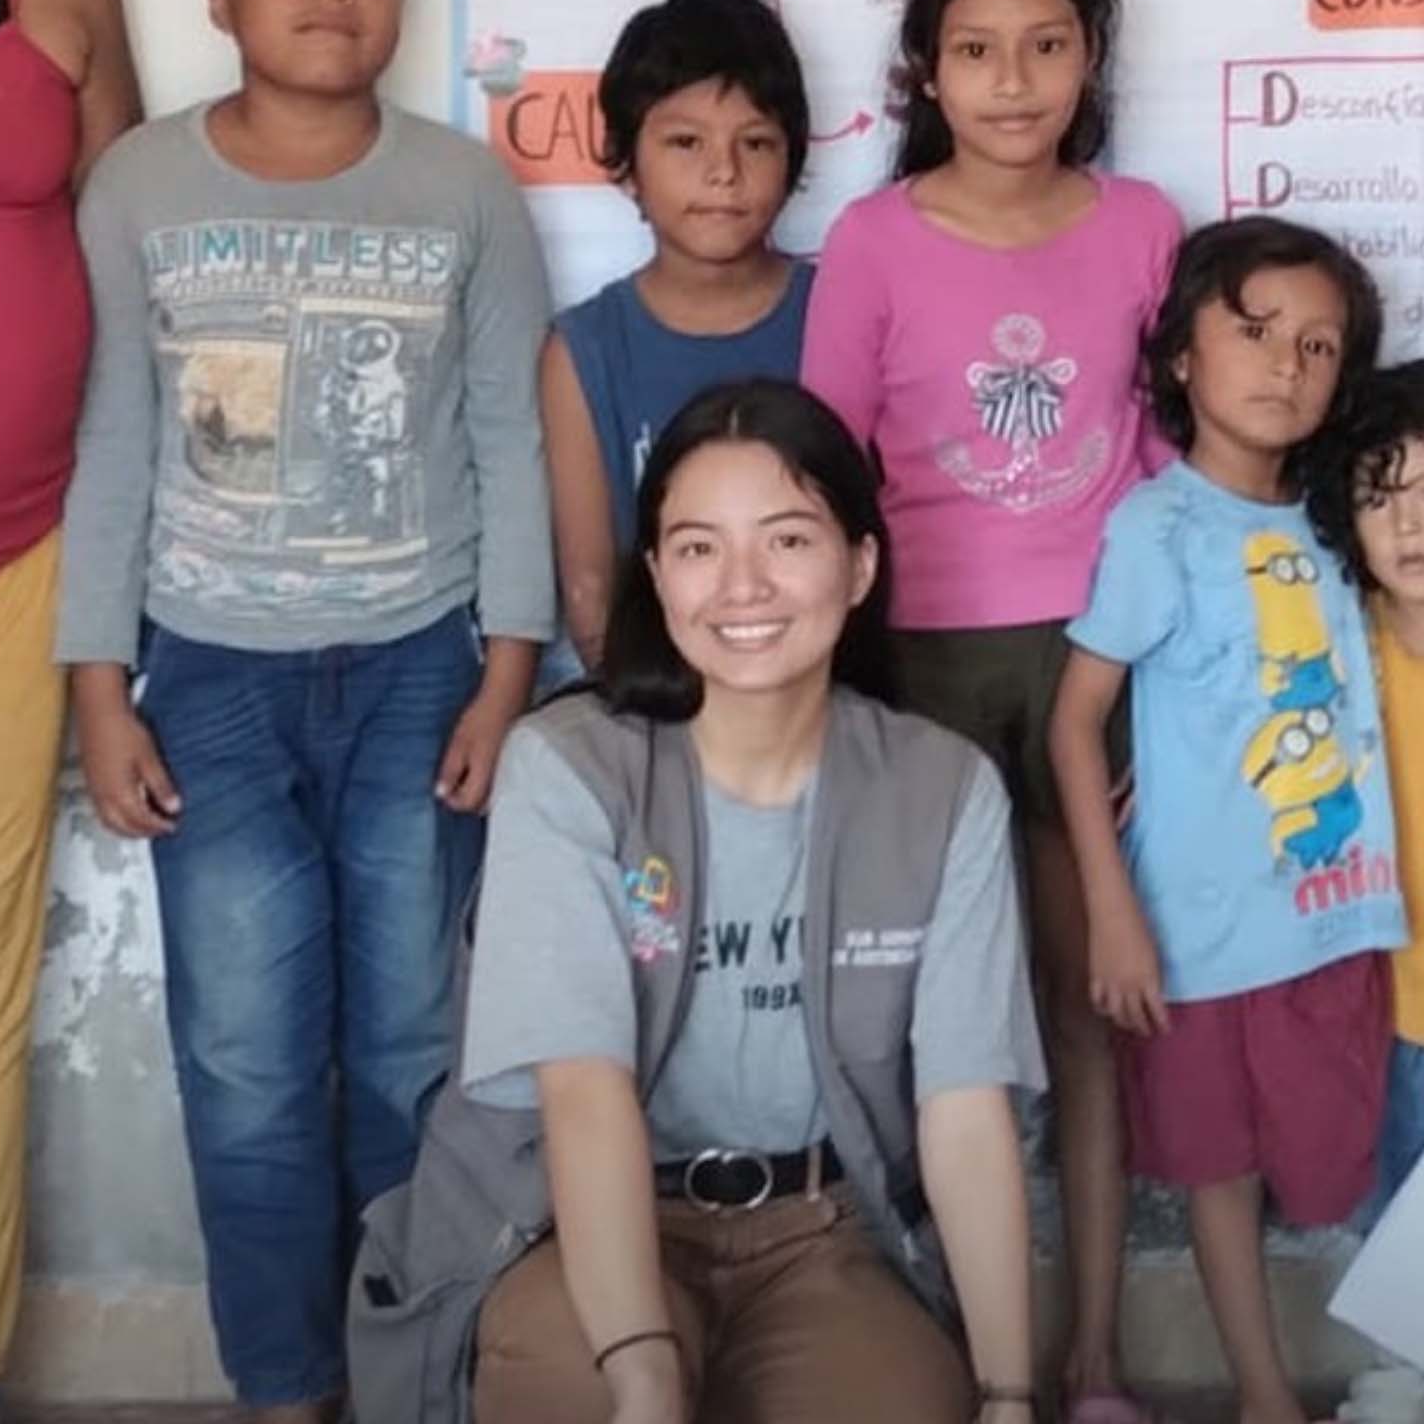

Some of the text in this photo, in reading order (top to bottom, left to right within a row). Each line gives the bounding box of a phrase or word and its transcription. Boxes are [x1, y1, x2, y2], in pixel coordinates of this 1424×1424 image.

[507, 90, 616, 170] CAU
[1258, 161, 1419, 210] Desarrollo
[146, 228, 452, 278] LIMITLESS
